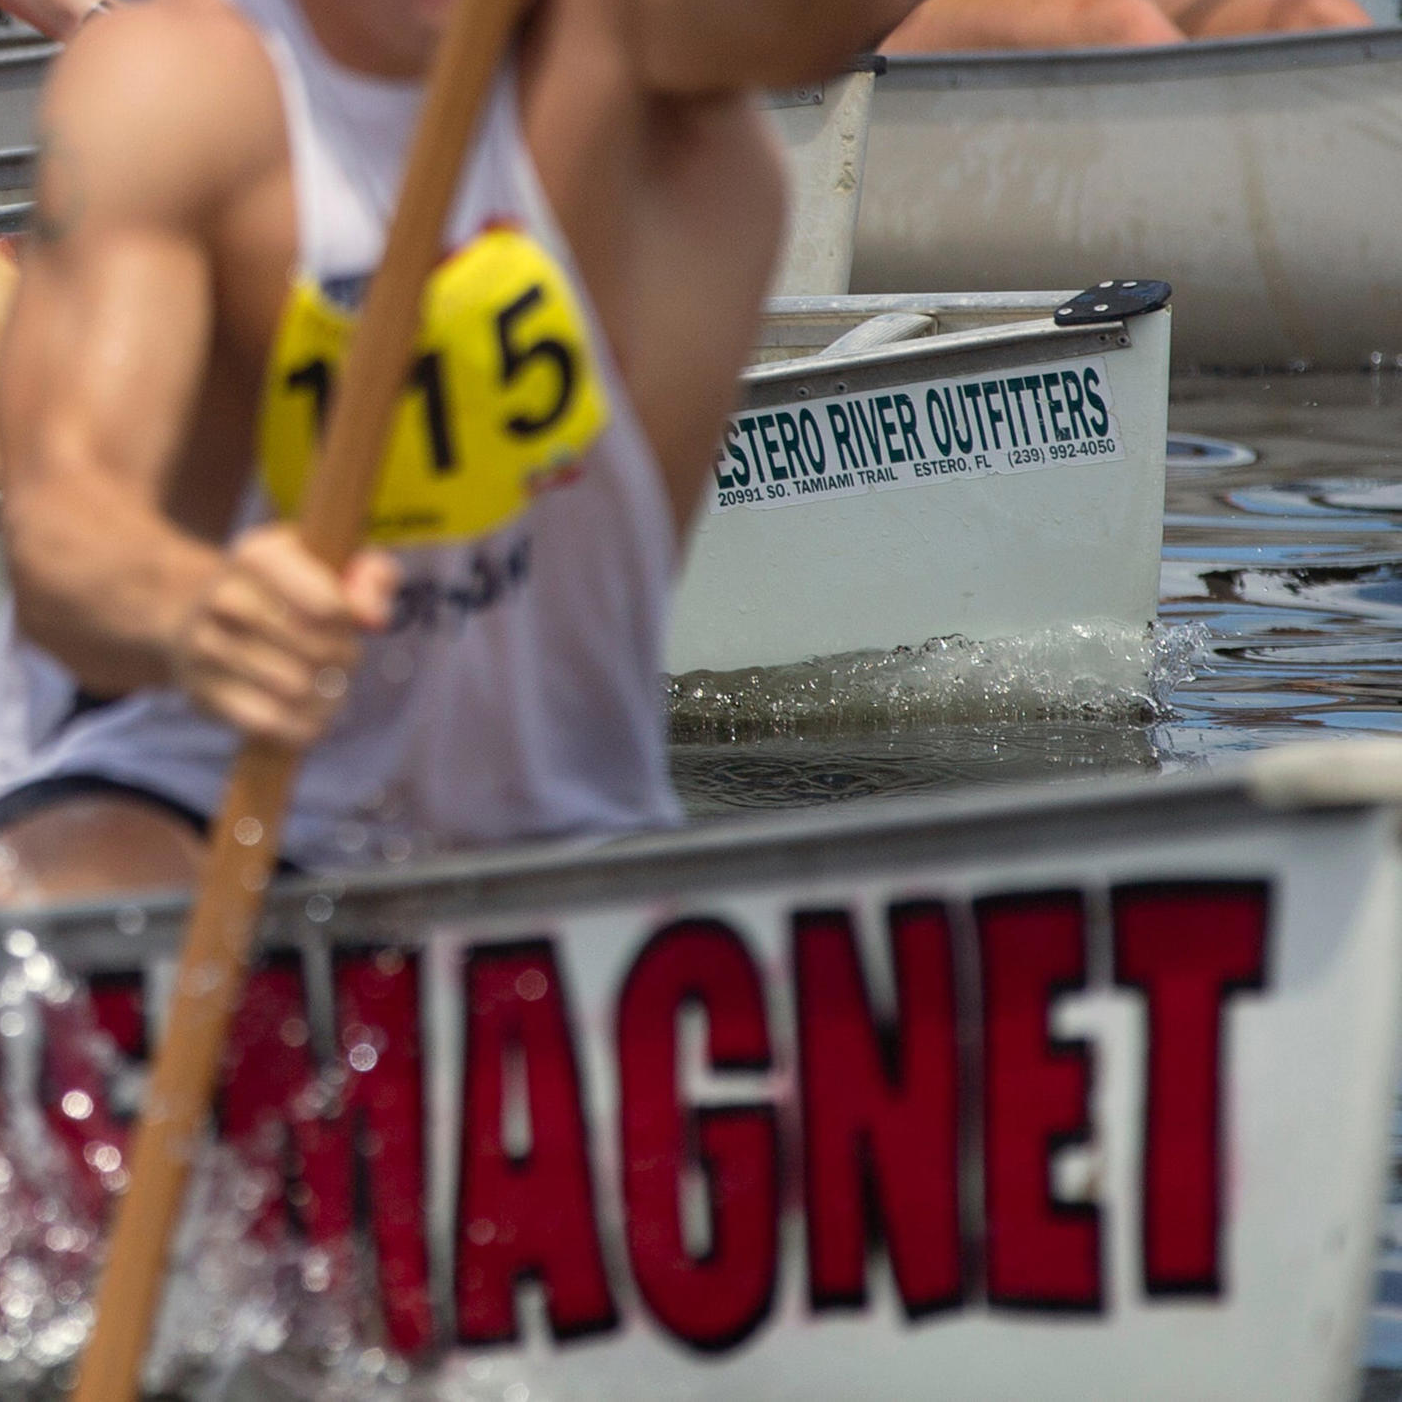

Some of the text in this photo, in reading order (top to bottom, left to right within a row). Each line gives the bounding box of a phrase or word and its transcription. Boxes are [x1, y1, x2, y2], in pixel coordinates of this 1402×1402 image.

[712, 366, 1110, 490] ESTERO RIVER OUTFITTERS
[718, 436, 1116, 507] 20991 SO. TAMIAMI TRAIL ESTERO, FL (239) 992-4050
[215, 876, 1274, 1358] MAGNET
